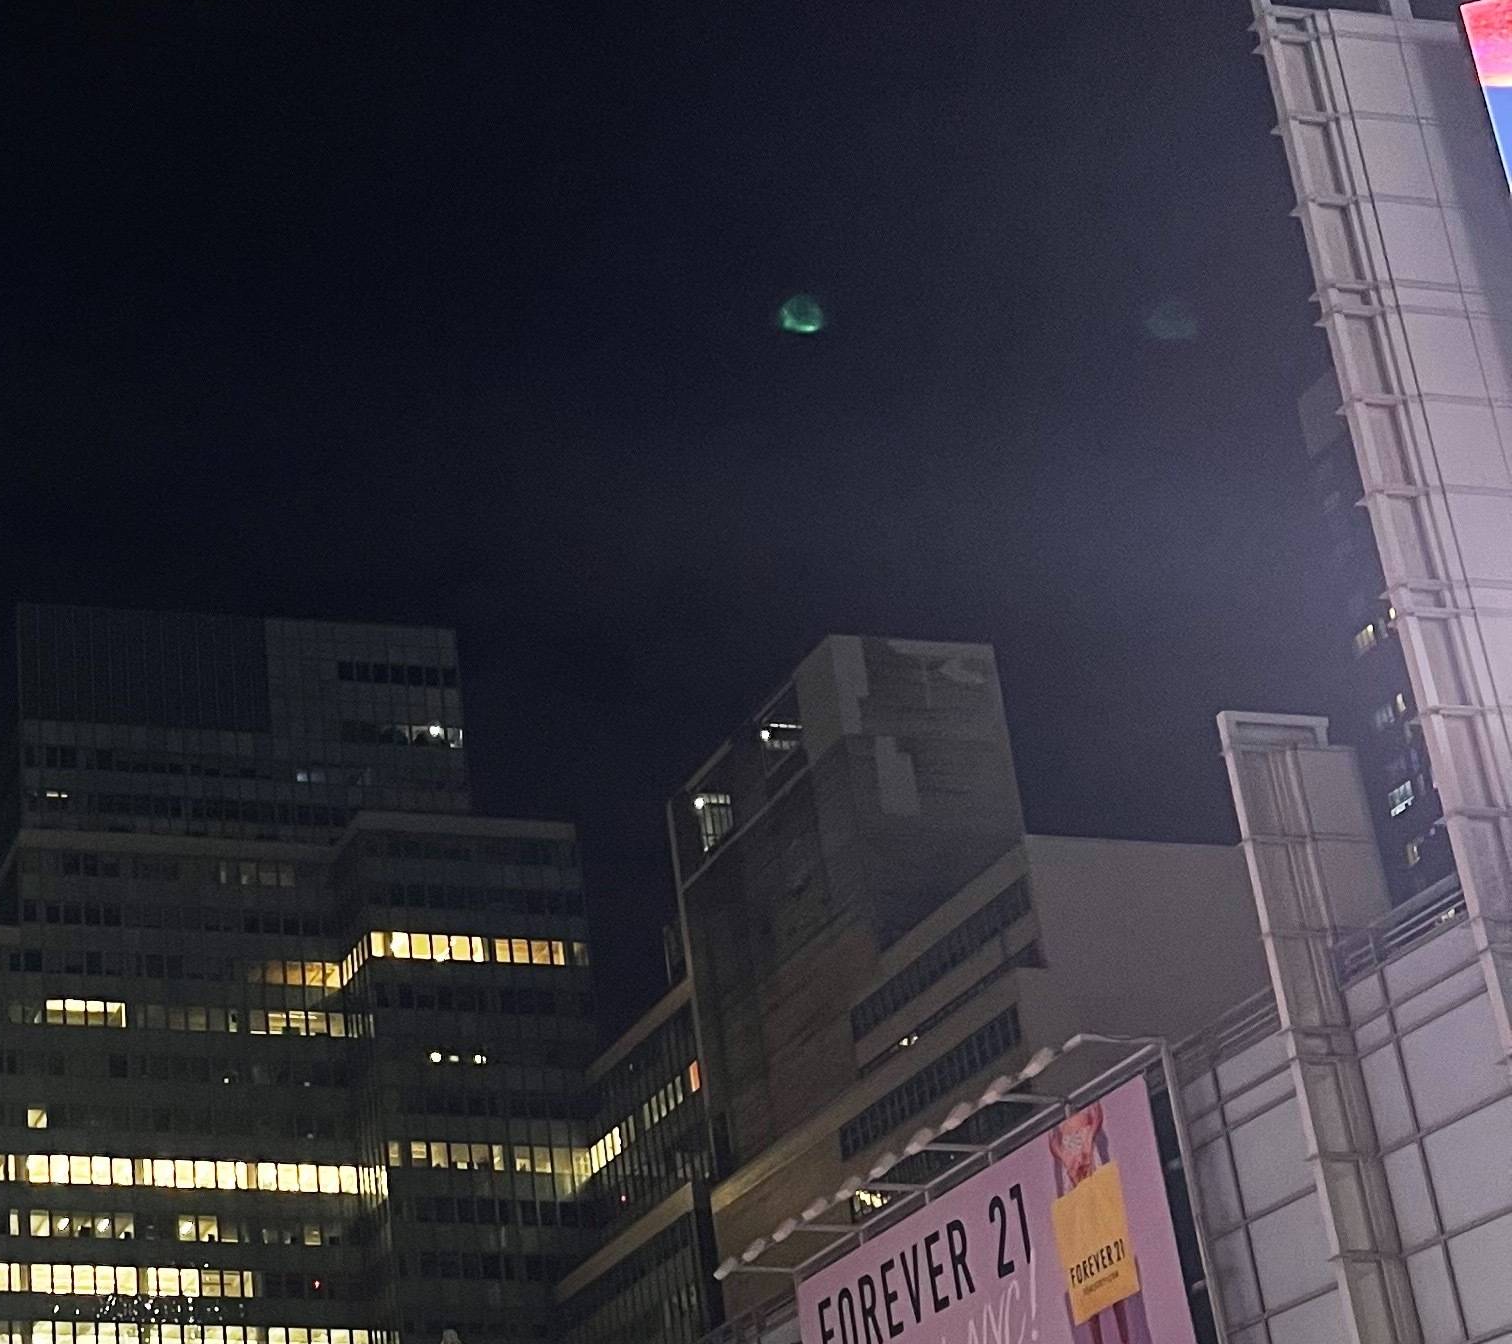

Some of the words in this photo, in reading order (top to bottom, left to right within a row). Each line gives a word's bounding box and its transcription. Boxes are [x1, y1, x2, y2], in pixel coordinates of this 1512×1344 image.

[989, 1184, 1031, 1278] 21
[1070, 1245, 1114, 1288] FOREVER
[1114, 1238, 1126, 1262] 21
